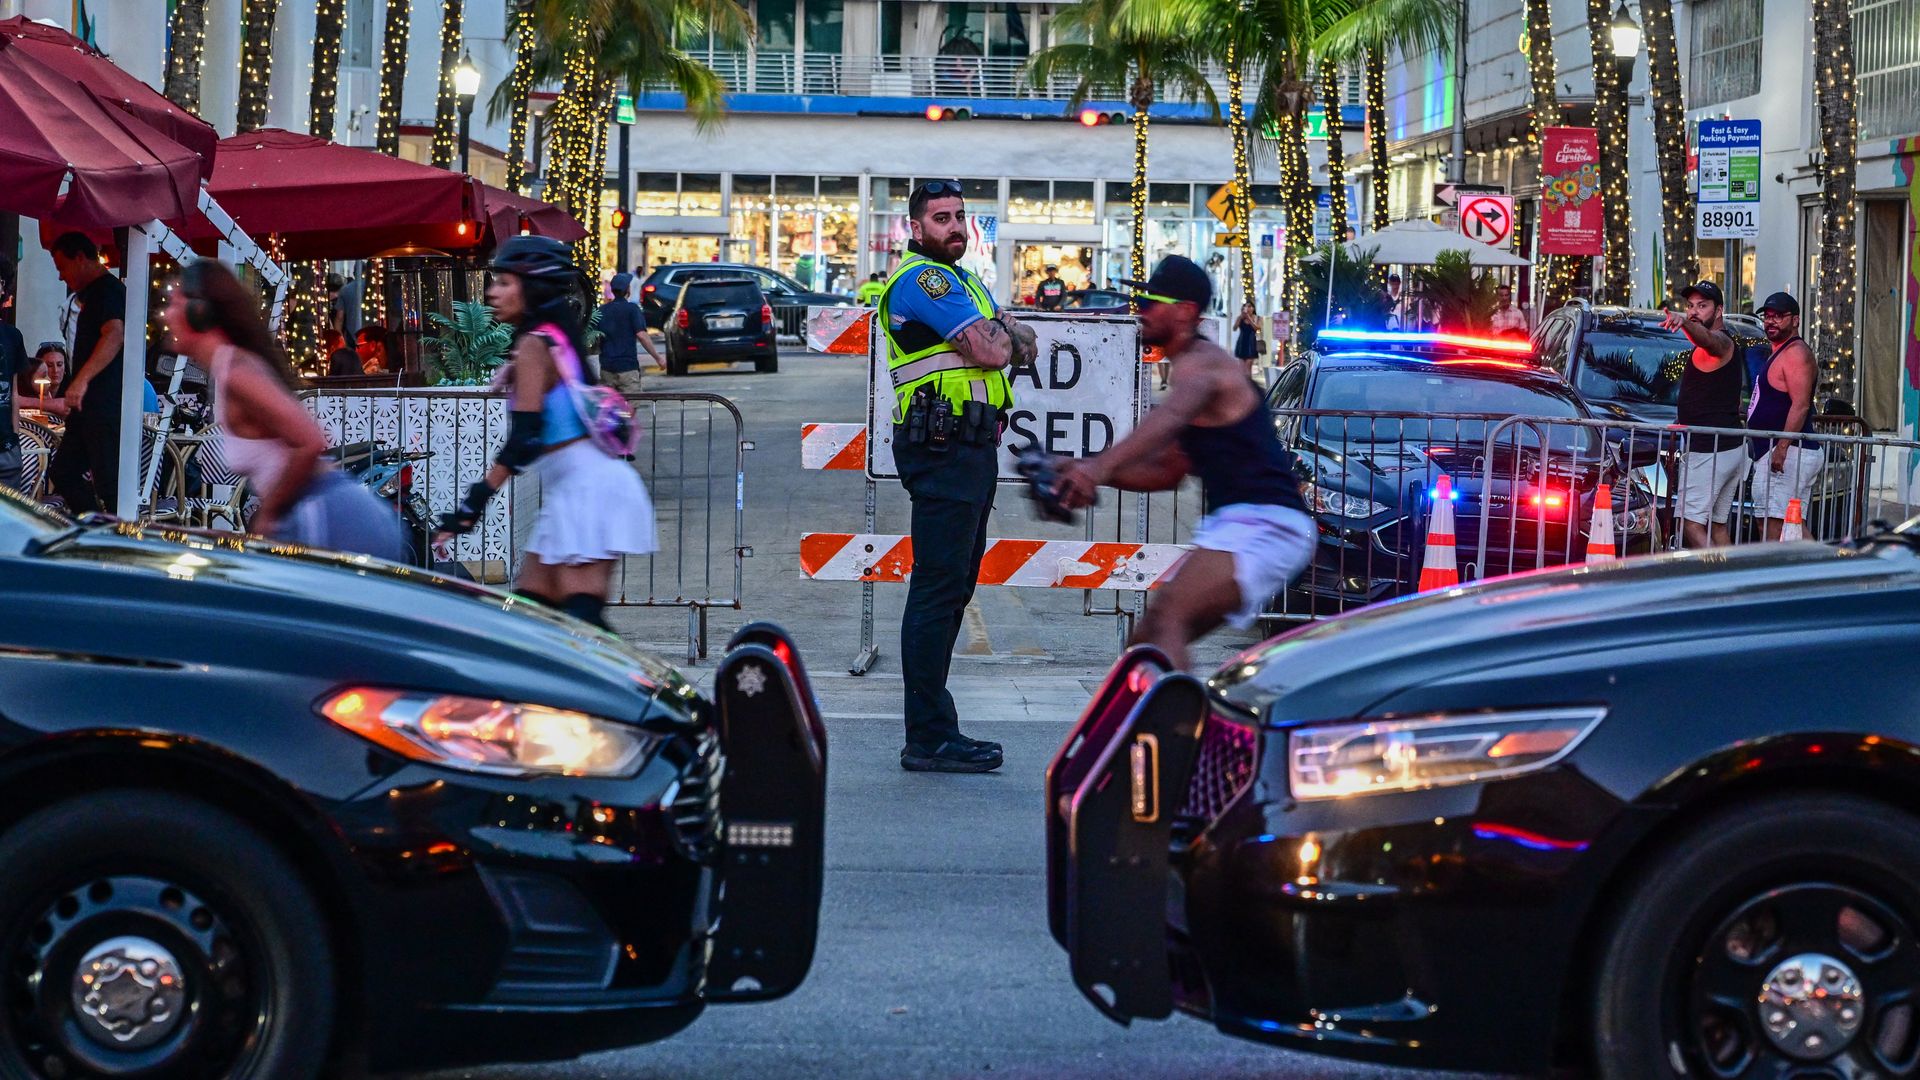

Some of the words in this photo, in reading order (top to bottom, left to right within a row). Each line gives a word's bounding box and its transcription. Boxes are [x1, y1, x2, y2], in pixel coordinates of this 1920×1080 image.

[1726, 126, 1732, 134] &
[1733, 126, 1749, 135] Easy
[1700, 134, 1727, 144] Parking
[1727, 133, 1760, 143] Payments
[1702, 211, 1754, 227] 88901
[918, 269, 938, 283] POLICE
[1007, 342, 1082, 390] AD
[1000, 409, 1114, 459] SED
